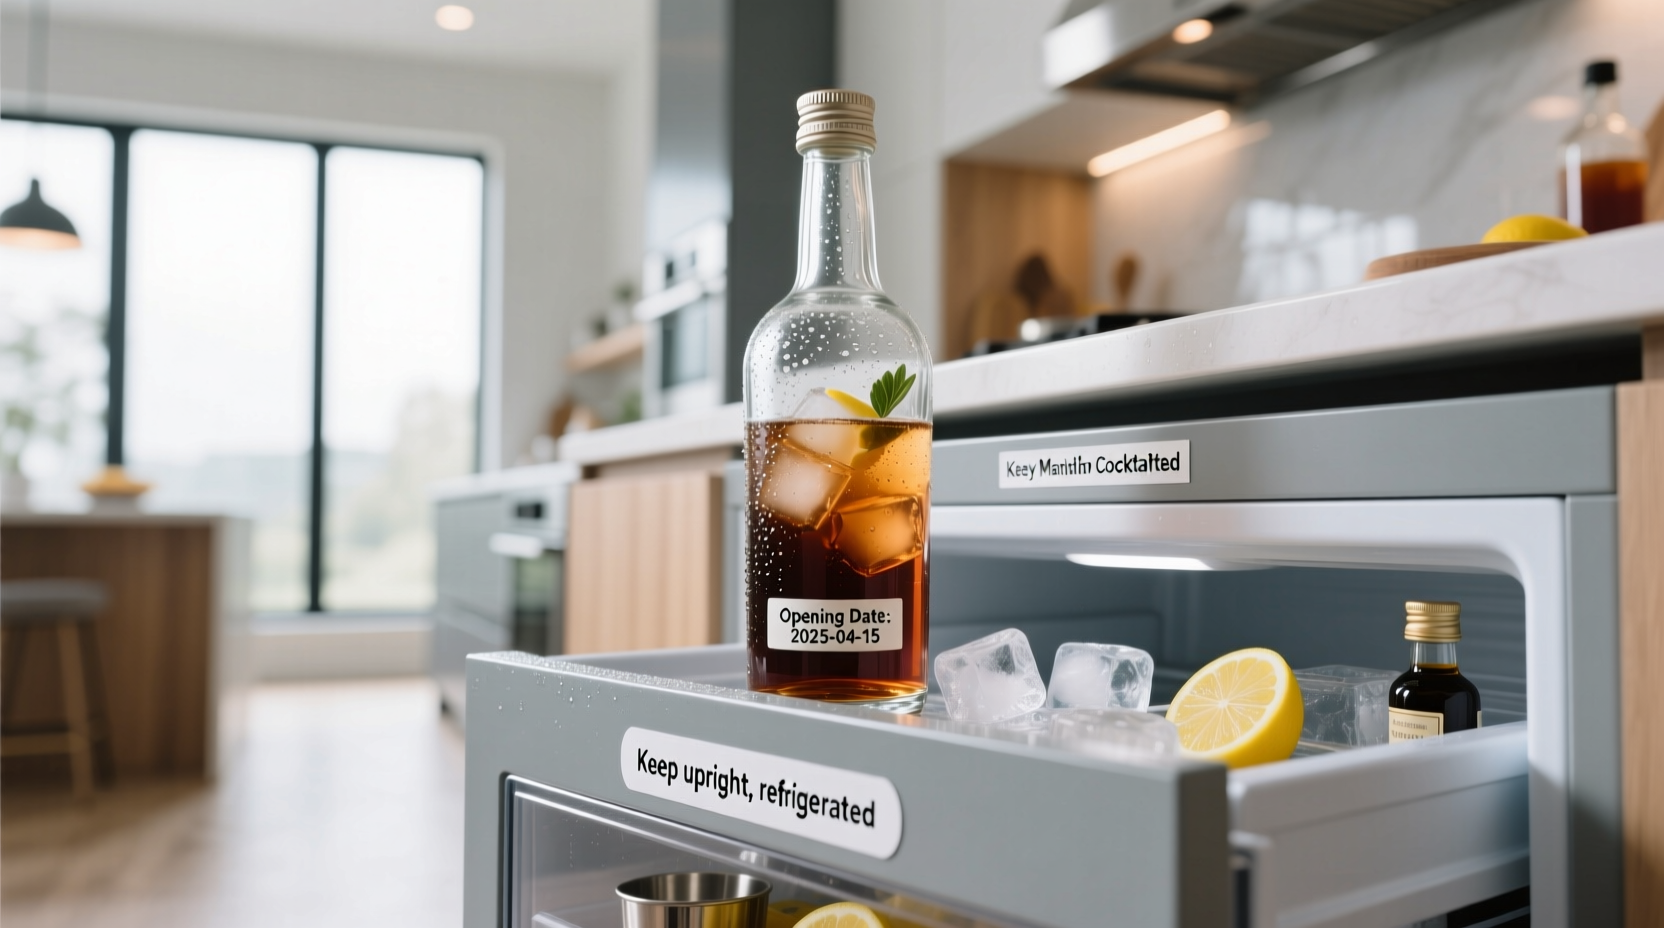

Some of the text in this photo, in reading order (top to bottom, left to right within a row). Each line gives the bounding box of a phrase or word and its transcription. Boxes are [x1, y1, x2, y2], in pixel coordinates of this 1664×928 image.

[779, 607, 891, 628] Opening Date:
[791, 628, 880, 644] 2025-04-15
[637, 747, 876, 828] Keep upright, refrigerated
